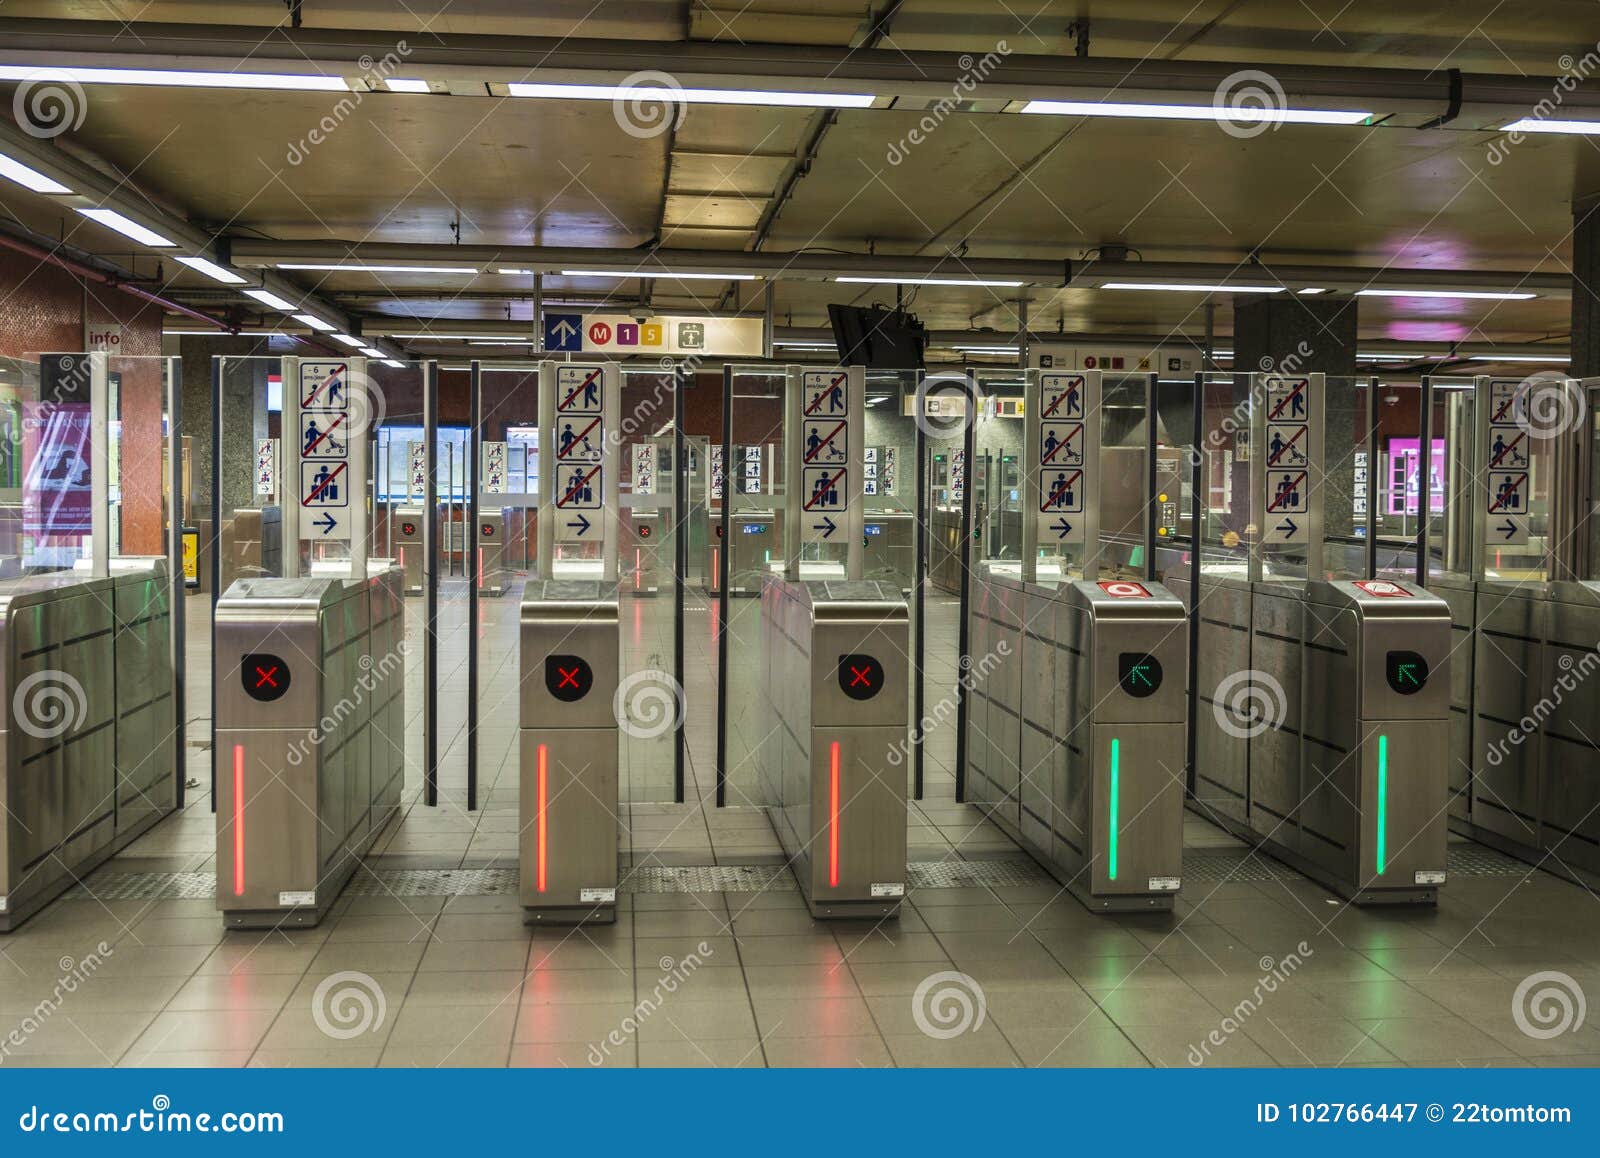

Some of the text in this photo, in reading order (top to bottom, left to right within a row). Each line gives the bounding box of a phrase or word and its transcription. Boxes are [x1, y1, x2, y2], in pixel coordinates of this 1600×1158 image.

[90, 331, 120, 345] info
[593, 328, 655, 340] M 1 5
